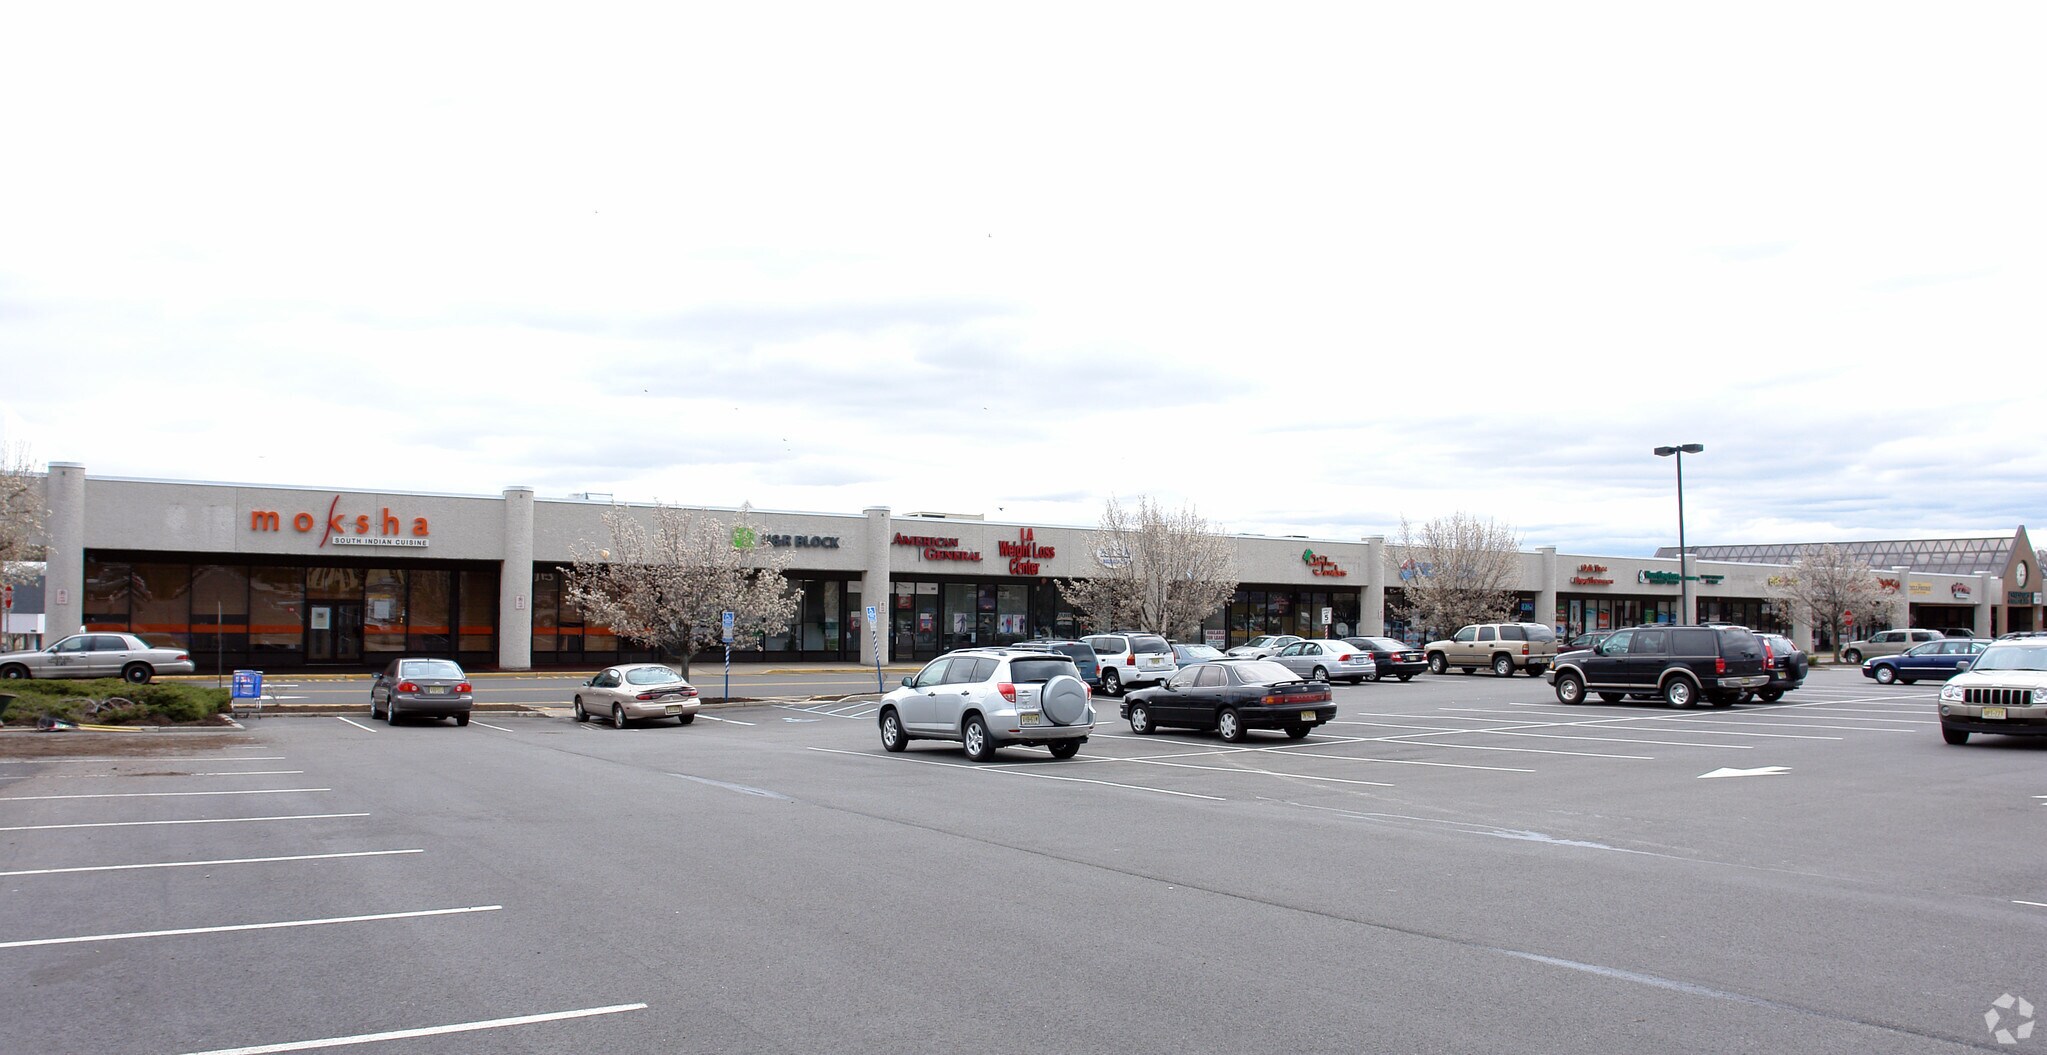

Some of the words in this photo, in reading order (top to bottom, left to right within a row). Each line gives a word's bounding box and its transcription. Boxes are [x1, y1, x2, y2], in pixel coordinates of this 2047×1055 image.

[251, 495, 429, 548] moksha
[795, 535, 839, 548] BLOCK
[891, 532, 958, 548] AMERICAN
[1019, 528, 1034, 541] LA
[924, 548, 983, 561] GENERAL
[998, 541, 1032, 561] Weight
[1032, 542, 1055, 559] Loss
[1009, 558, 1039, 575] Center
